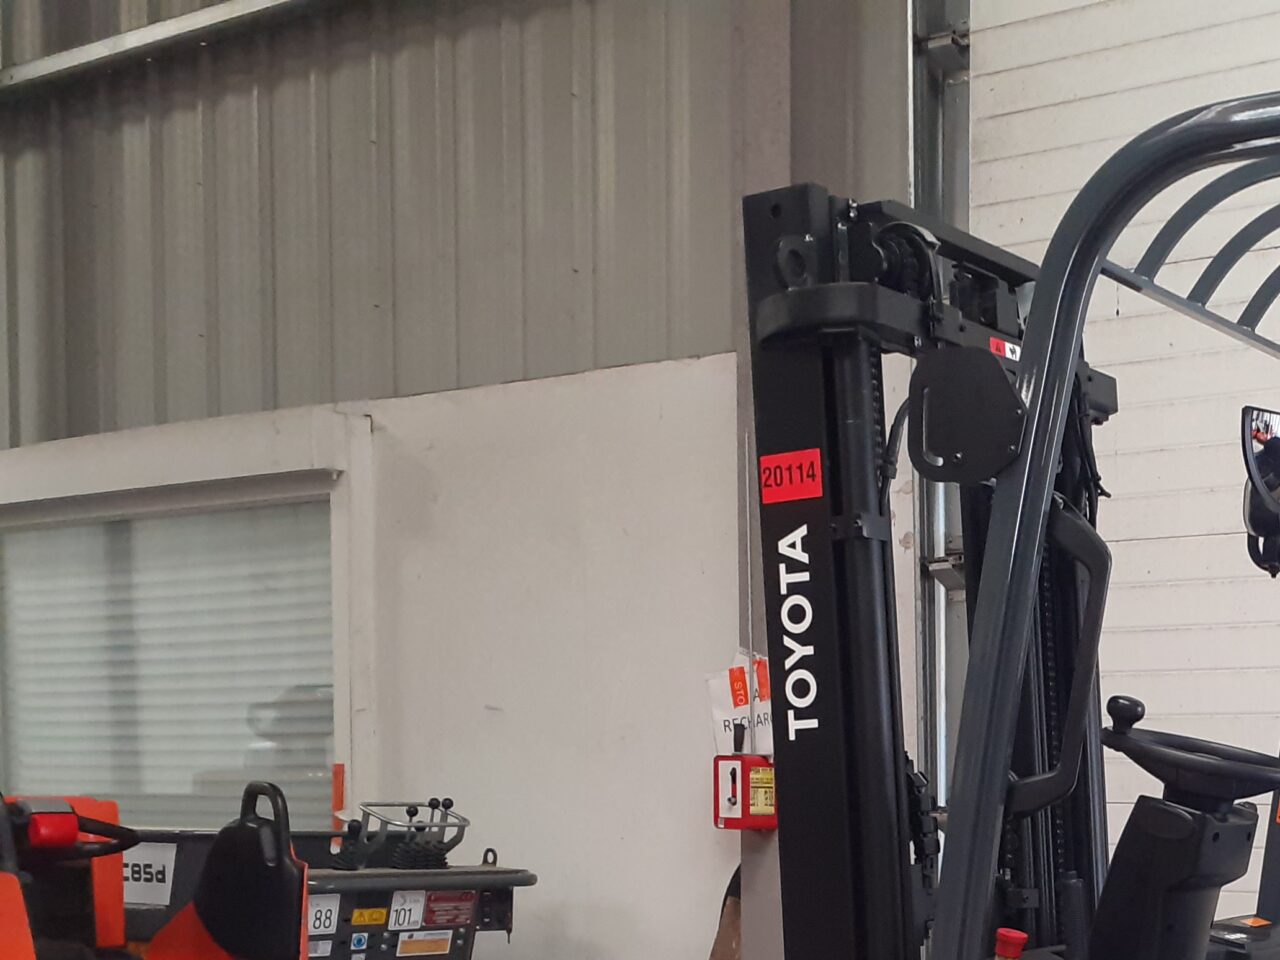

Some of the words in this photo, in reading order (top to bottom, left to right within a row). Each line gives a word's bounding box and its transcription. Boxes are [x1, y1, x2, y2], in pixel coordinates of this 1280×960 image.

[763, 460, 817, 488] 20114
[778, 524, 819, 741] TOYOTA
[723, 712, 772, 734] RECHAR
